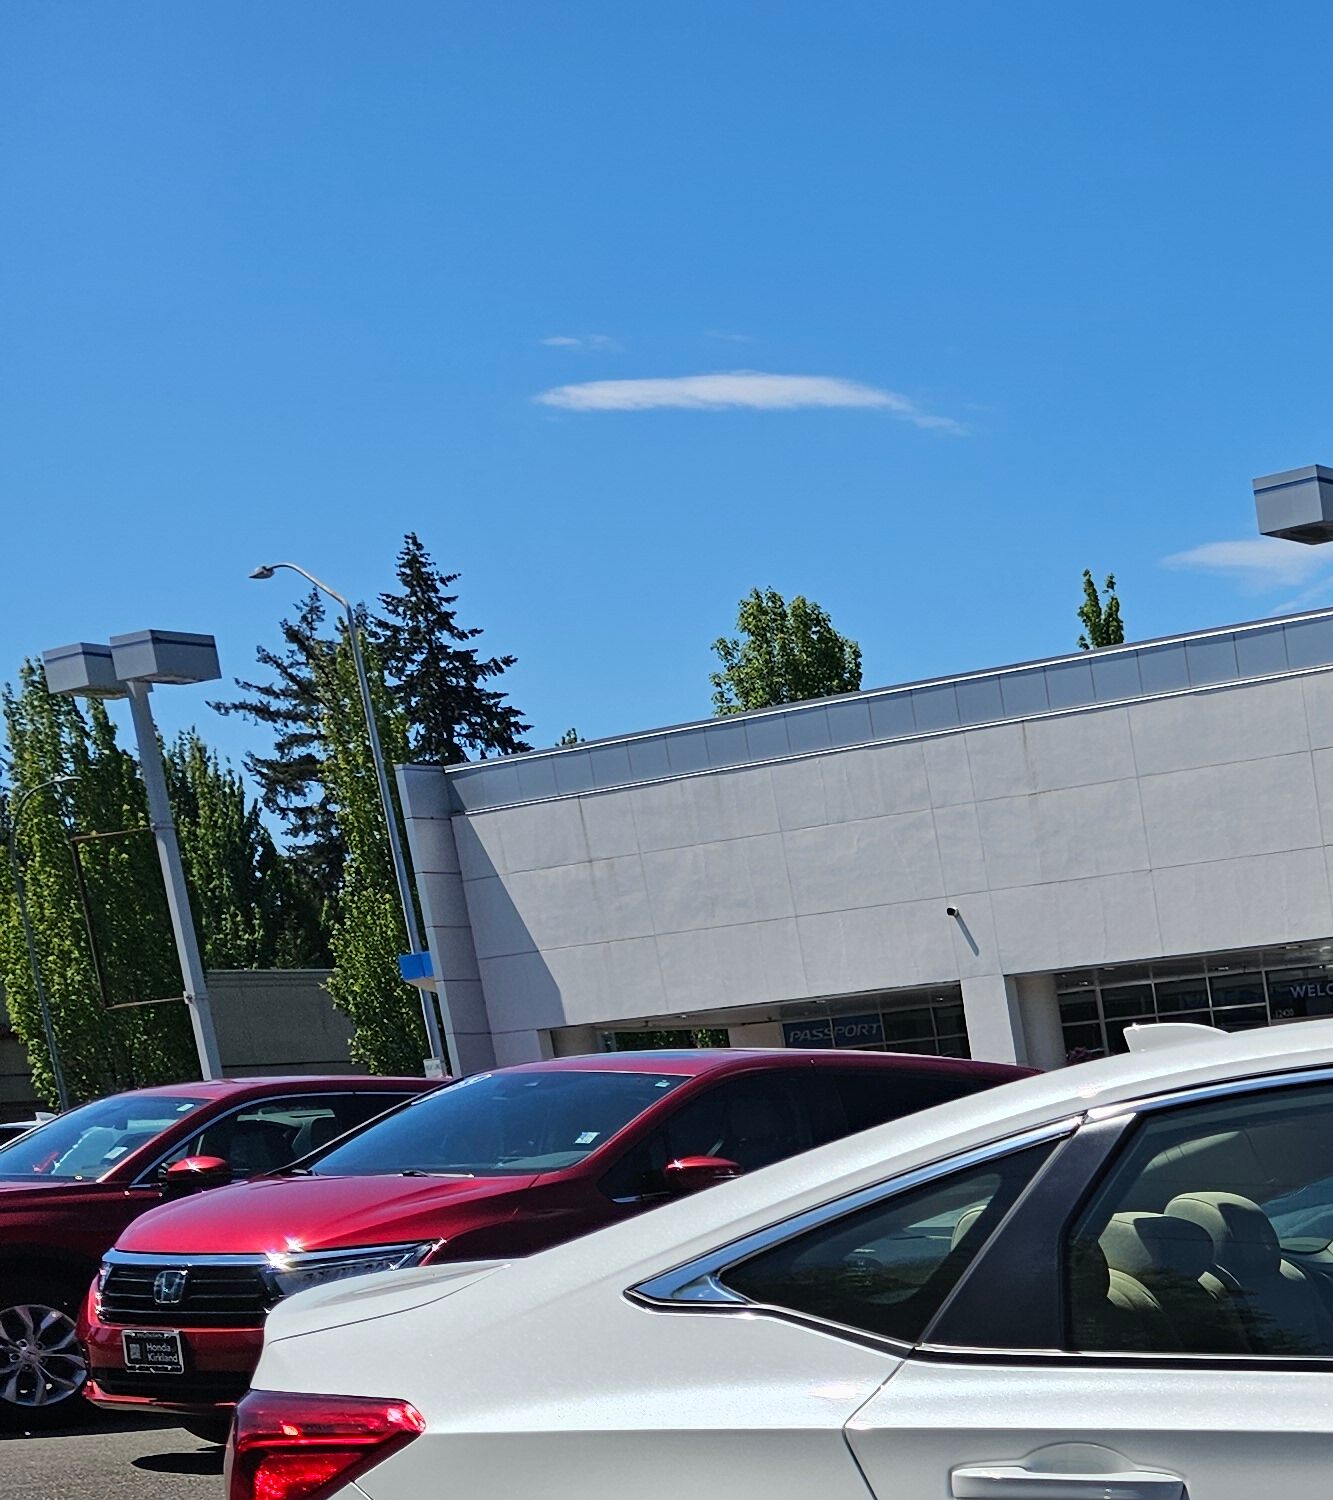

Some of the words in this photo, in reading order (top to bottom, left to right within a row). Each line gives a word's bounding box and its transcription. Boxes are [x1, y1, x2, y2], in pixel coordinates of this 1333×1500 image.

[789, 1022, 881, 1043] PASSPORT
[146, 1342, 171, 1351] Honda
[147, 1353, 178, 1362] Kirkland
